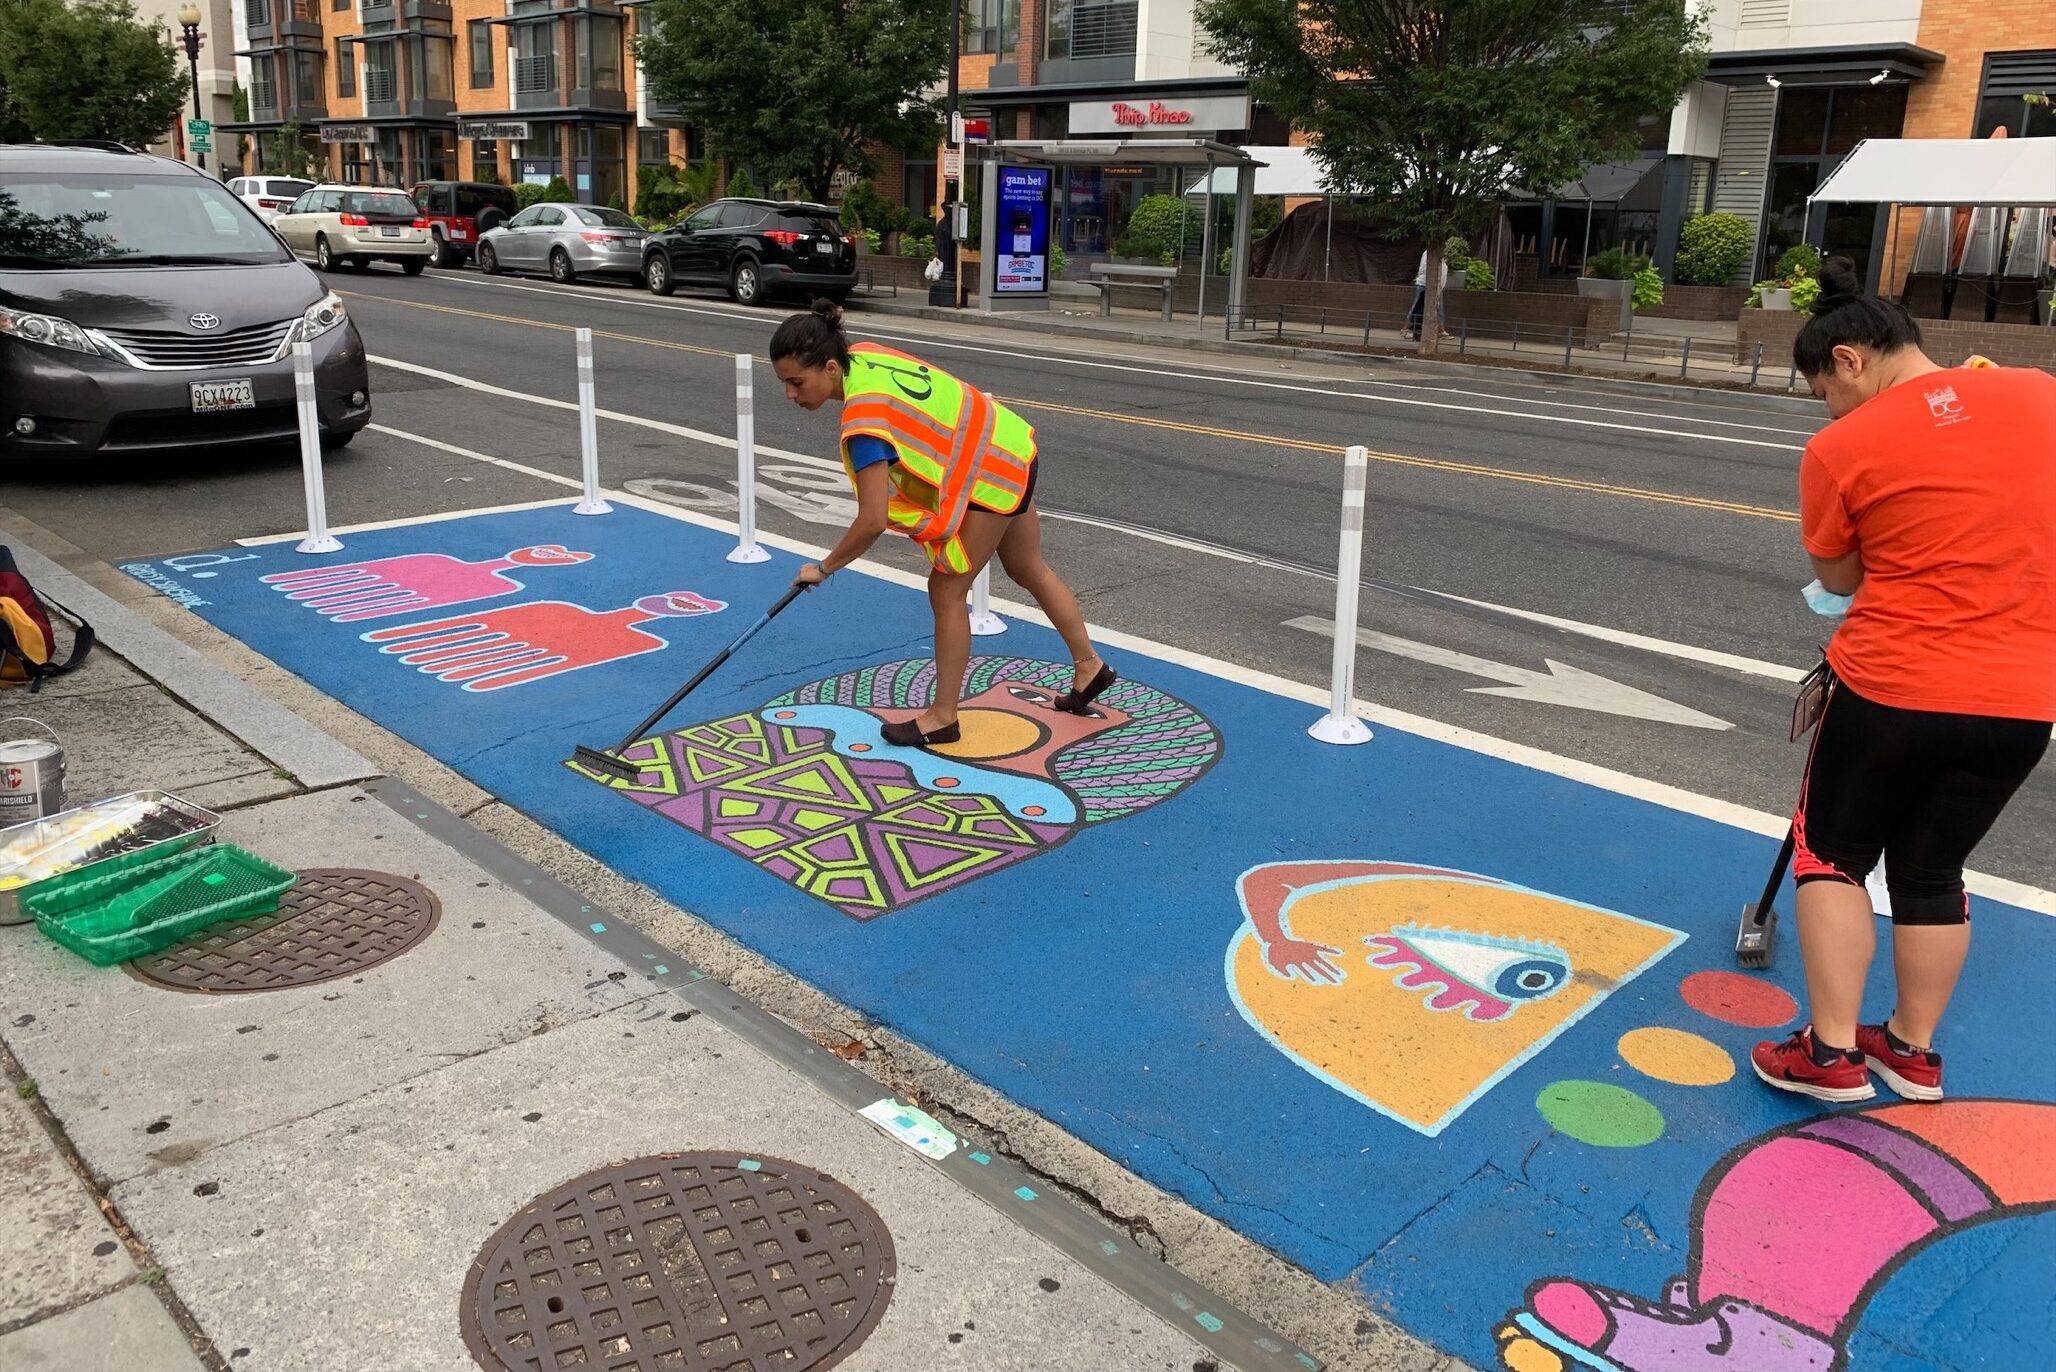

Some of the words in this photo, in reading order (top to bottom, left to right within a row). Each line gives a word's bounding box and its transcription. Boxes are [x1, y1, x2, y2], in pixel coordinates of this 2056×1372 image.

[1112, 103, 1147, 128] Thip
[1148, 102, 1194, 124] Khao
[1006, 176, 1026, 186] gam
[1027, 175, 1042, 186] bet
[194, 386, 251, 406] 9CX4223
